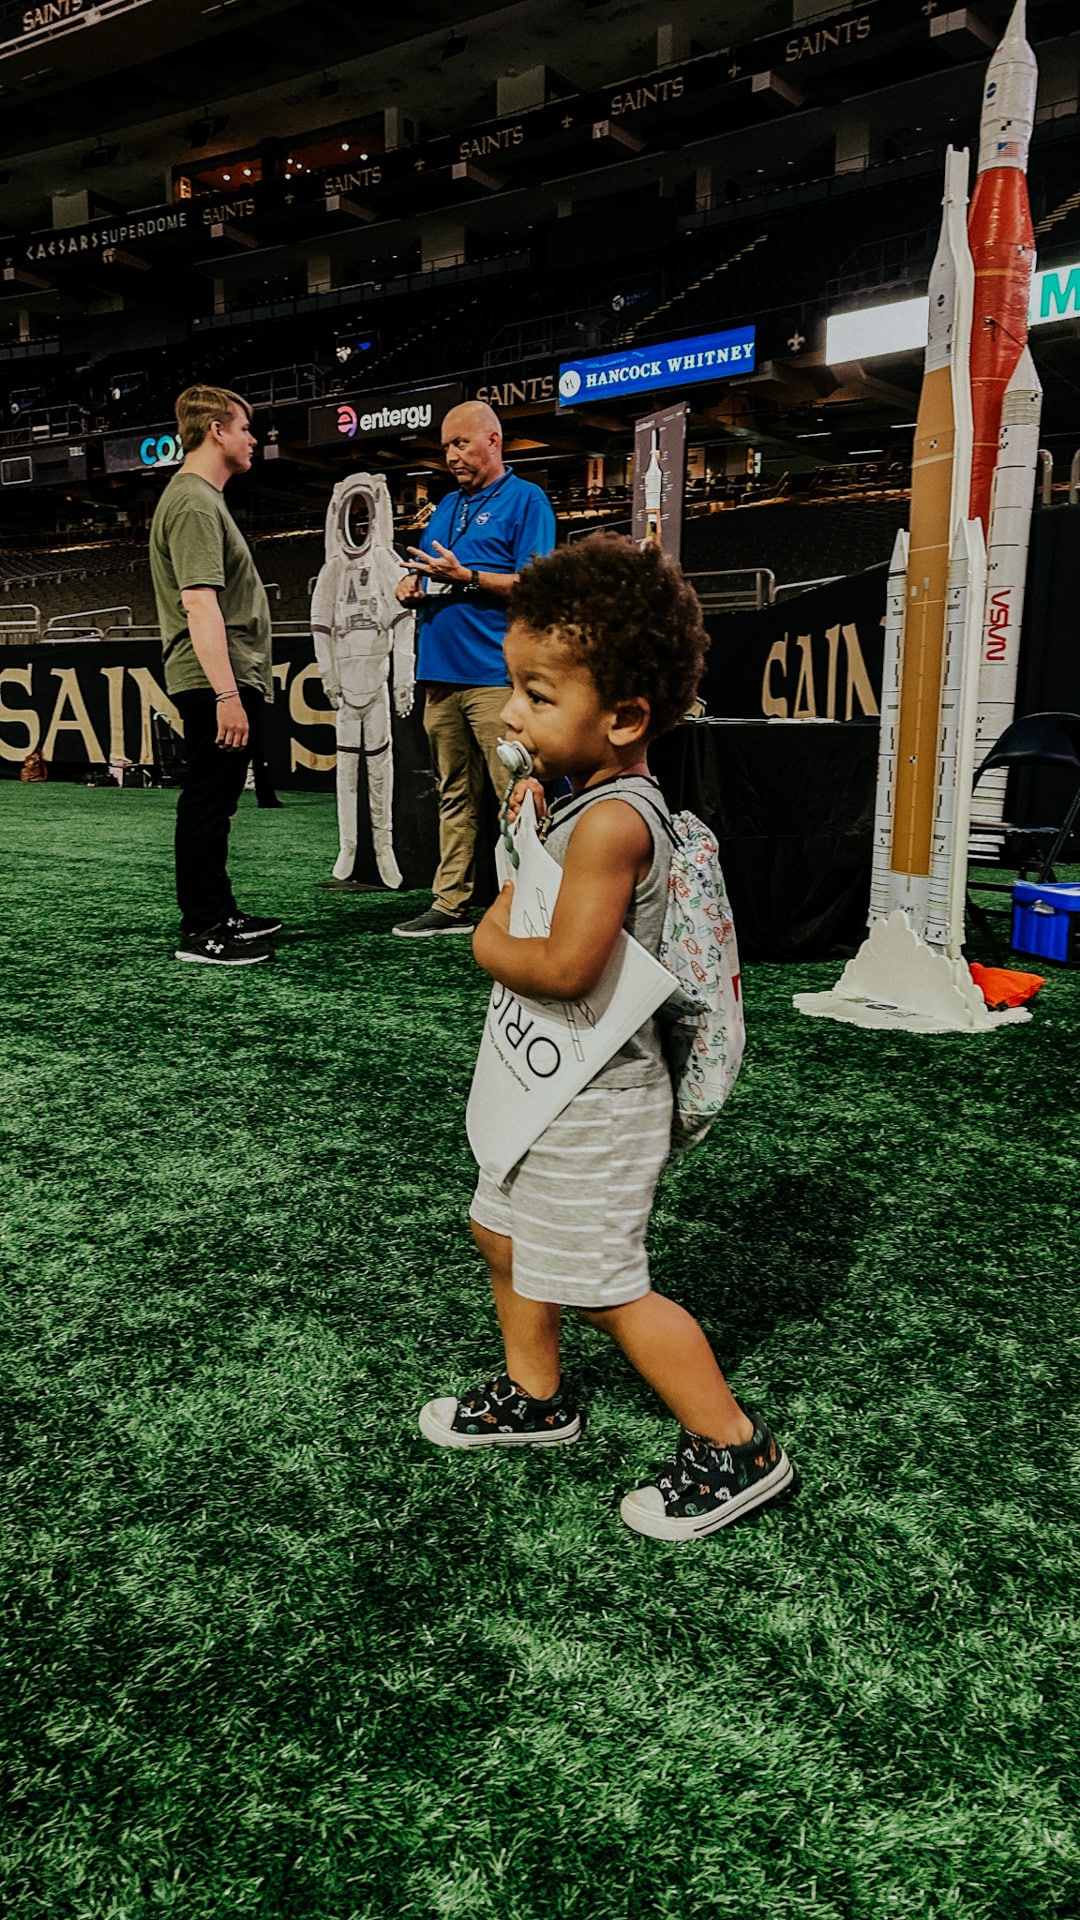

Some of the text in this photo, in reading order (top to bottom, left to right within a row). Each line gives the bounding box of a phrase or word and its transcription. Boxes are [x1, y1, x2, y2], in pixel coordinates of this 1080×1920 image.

[23, 0, 82, 32] SAINTS
[785, 15, 871, 63] SAINTS
[610, 76, 684, 116] SAINTS
[459, 125, 524, 160] SAINTS
[324, 166, 382, 196] SAINTS
[202, 199, 256, 225] SAINTS
[26, 212, 187, 260] CAESARS SUPERDOME
[585, 343, 755, 388] HANCOCK WHITNEY
[476, 375, 554, 406] SAINTS
[360, 403, 432, 431] entergy
[985, 589, 1012, 661] NASA
[0, 661, 337, 773] SAINS
